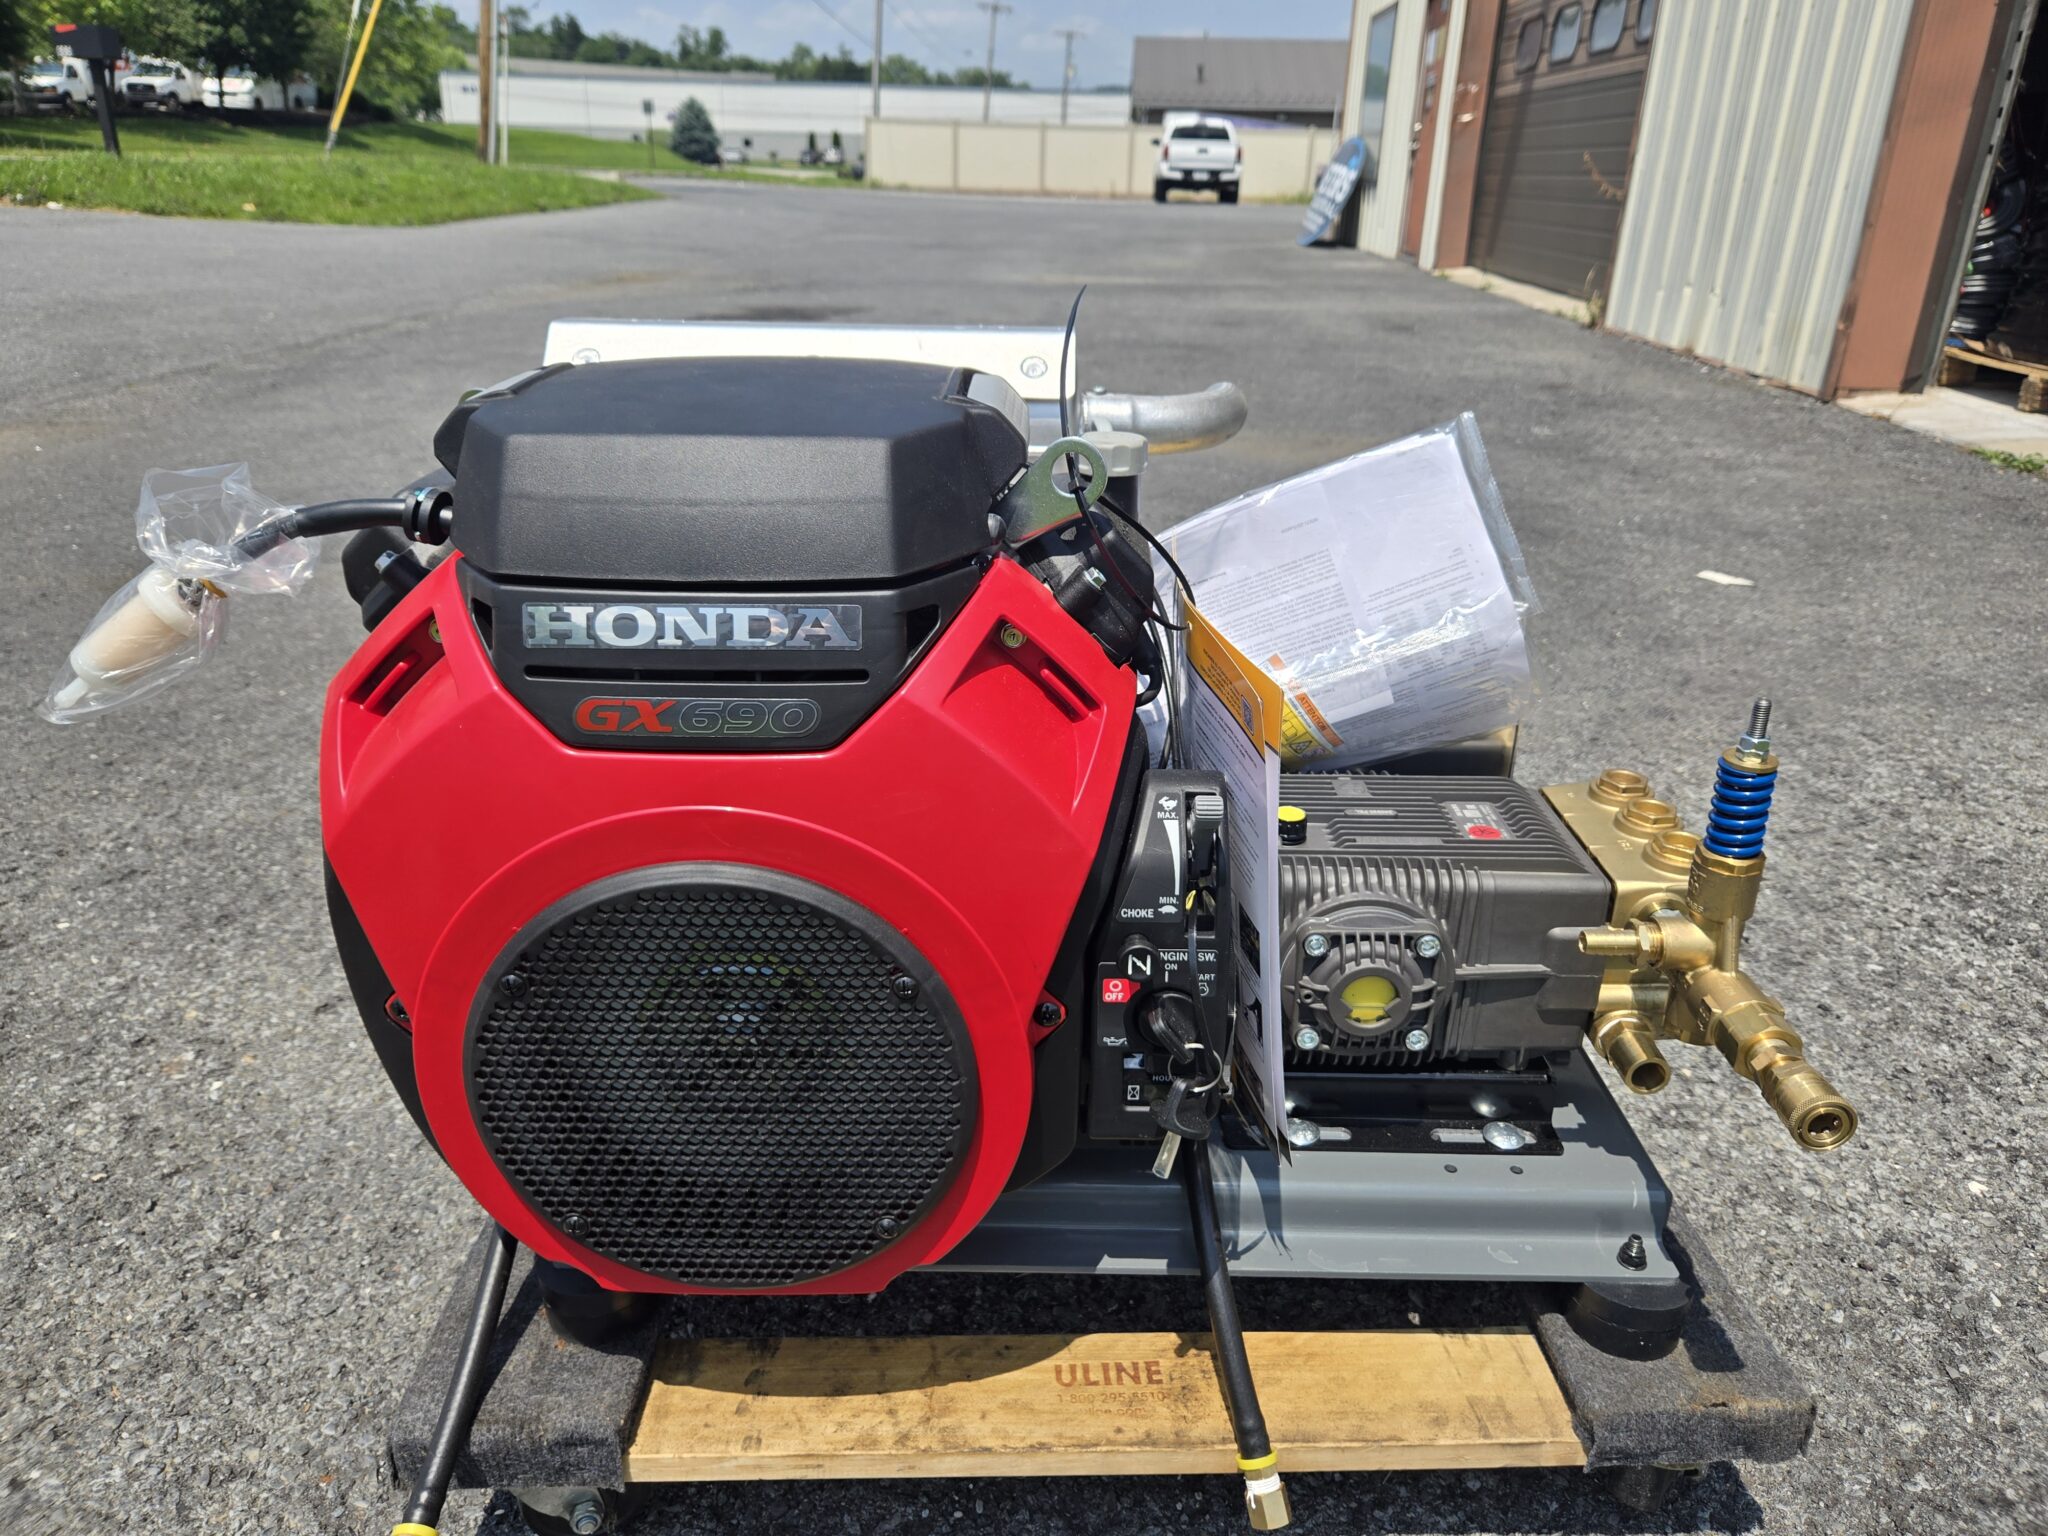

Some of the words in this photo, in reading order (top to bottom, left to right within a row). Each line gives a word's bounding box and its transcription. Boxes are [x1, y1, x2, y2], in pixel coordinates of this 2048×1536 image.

[526, 605, 858, 648] HONDA
[575, 698, 818, 734] GX690
[1157, 811, 1179, 819] MAX.
[1120, 908, 1154, 918] CHOKE
[1159, 951, 1188, 962] NGIN
[1197, 952, 1217, 962] SW.
[1164, 963, 1178, 971] ON
[1197, 973, 1215, 981] ART
[1104, 992, 1124, 1001] OFF
[1054, 1360, 1164, 1387] ULINE
